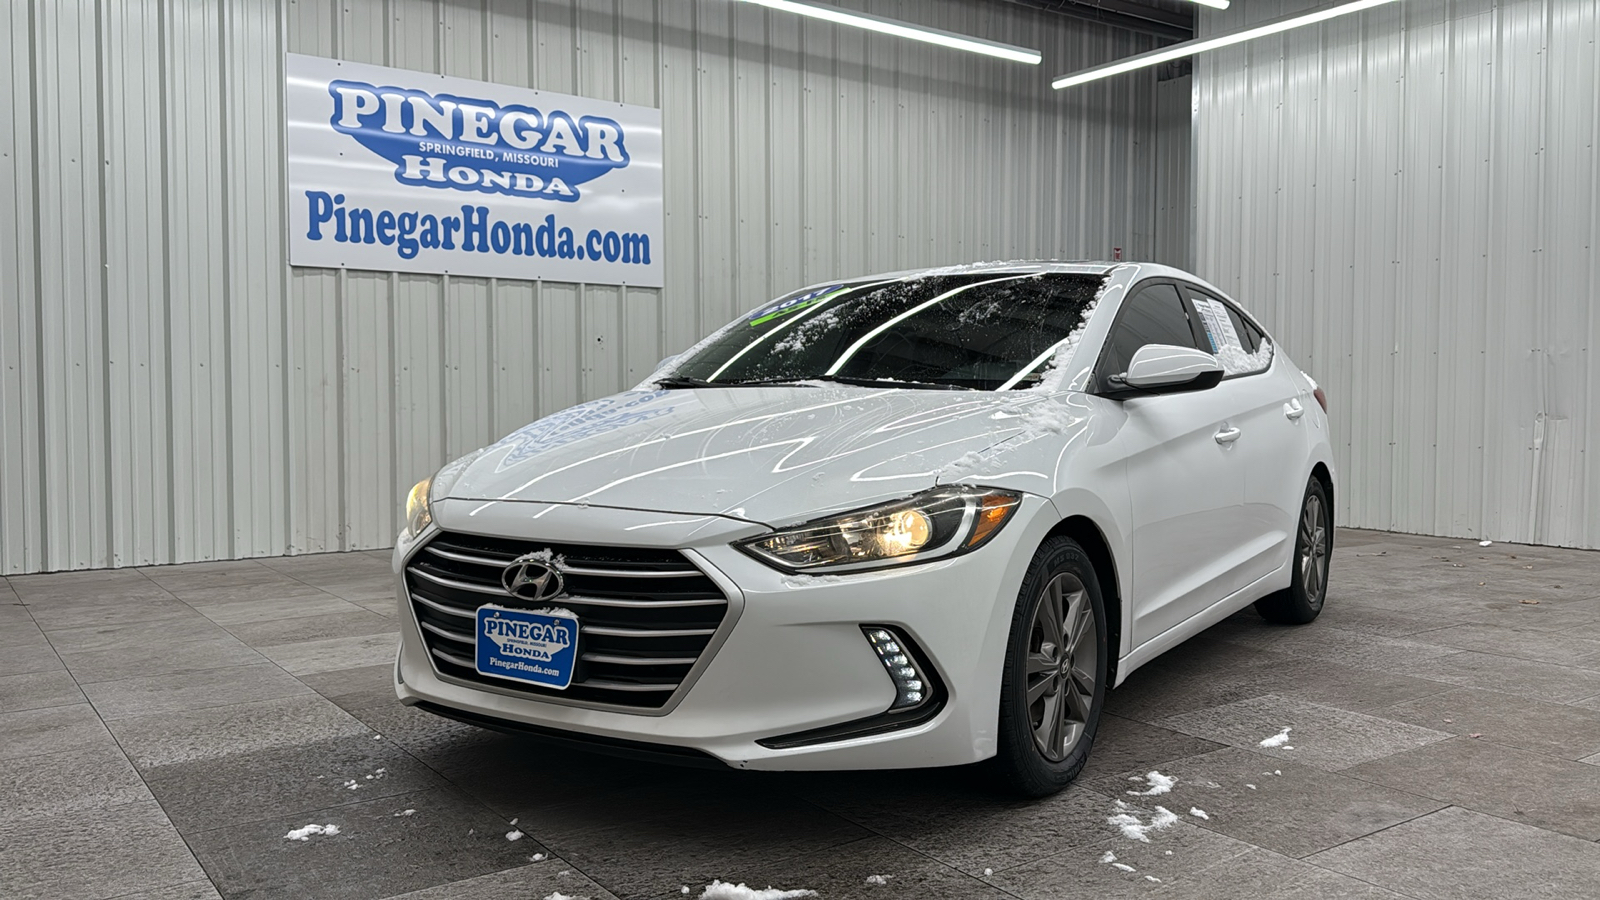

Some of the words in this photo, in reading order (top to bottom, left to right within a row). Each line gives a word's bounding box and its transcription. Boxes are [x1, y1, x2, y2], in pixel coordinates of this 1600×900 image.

[335, 87, 625, 163] PINEGAR
[419, 141, 500, 163] SPRINGFIELD,
[502, 151, 559, 168] MISSOURI
[402, 155, 575, 197] HONDA
[305, 190, 651, 265] PinegarHonda.com
[486, 620, 568, 645] PINEGAR
[502, 643, 550, 659] HONDA
[489, 657, 560, 677] PinegarHonda.com
